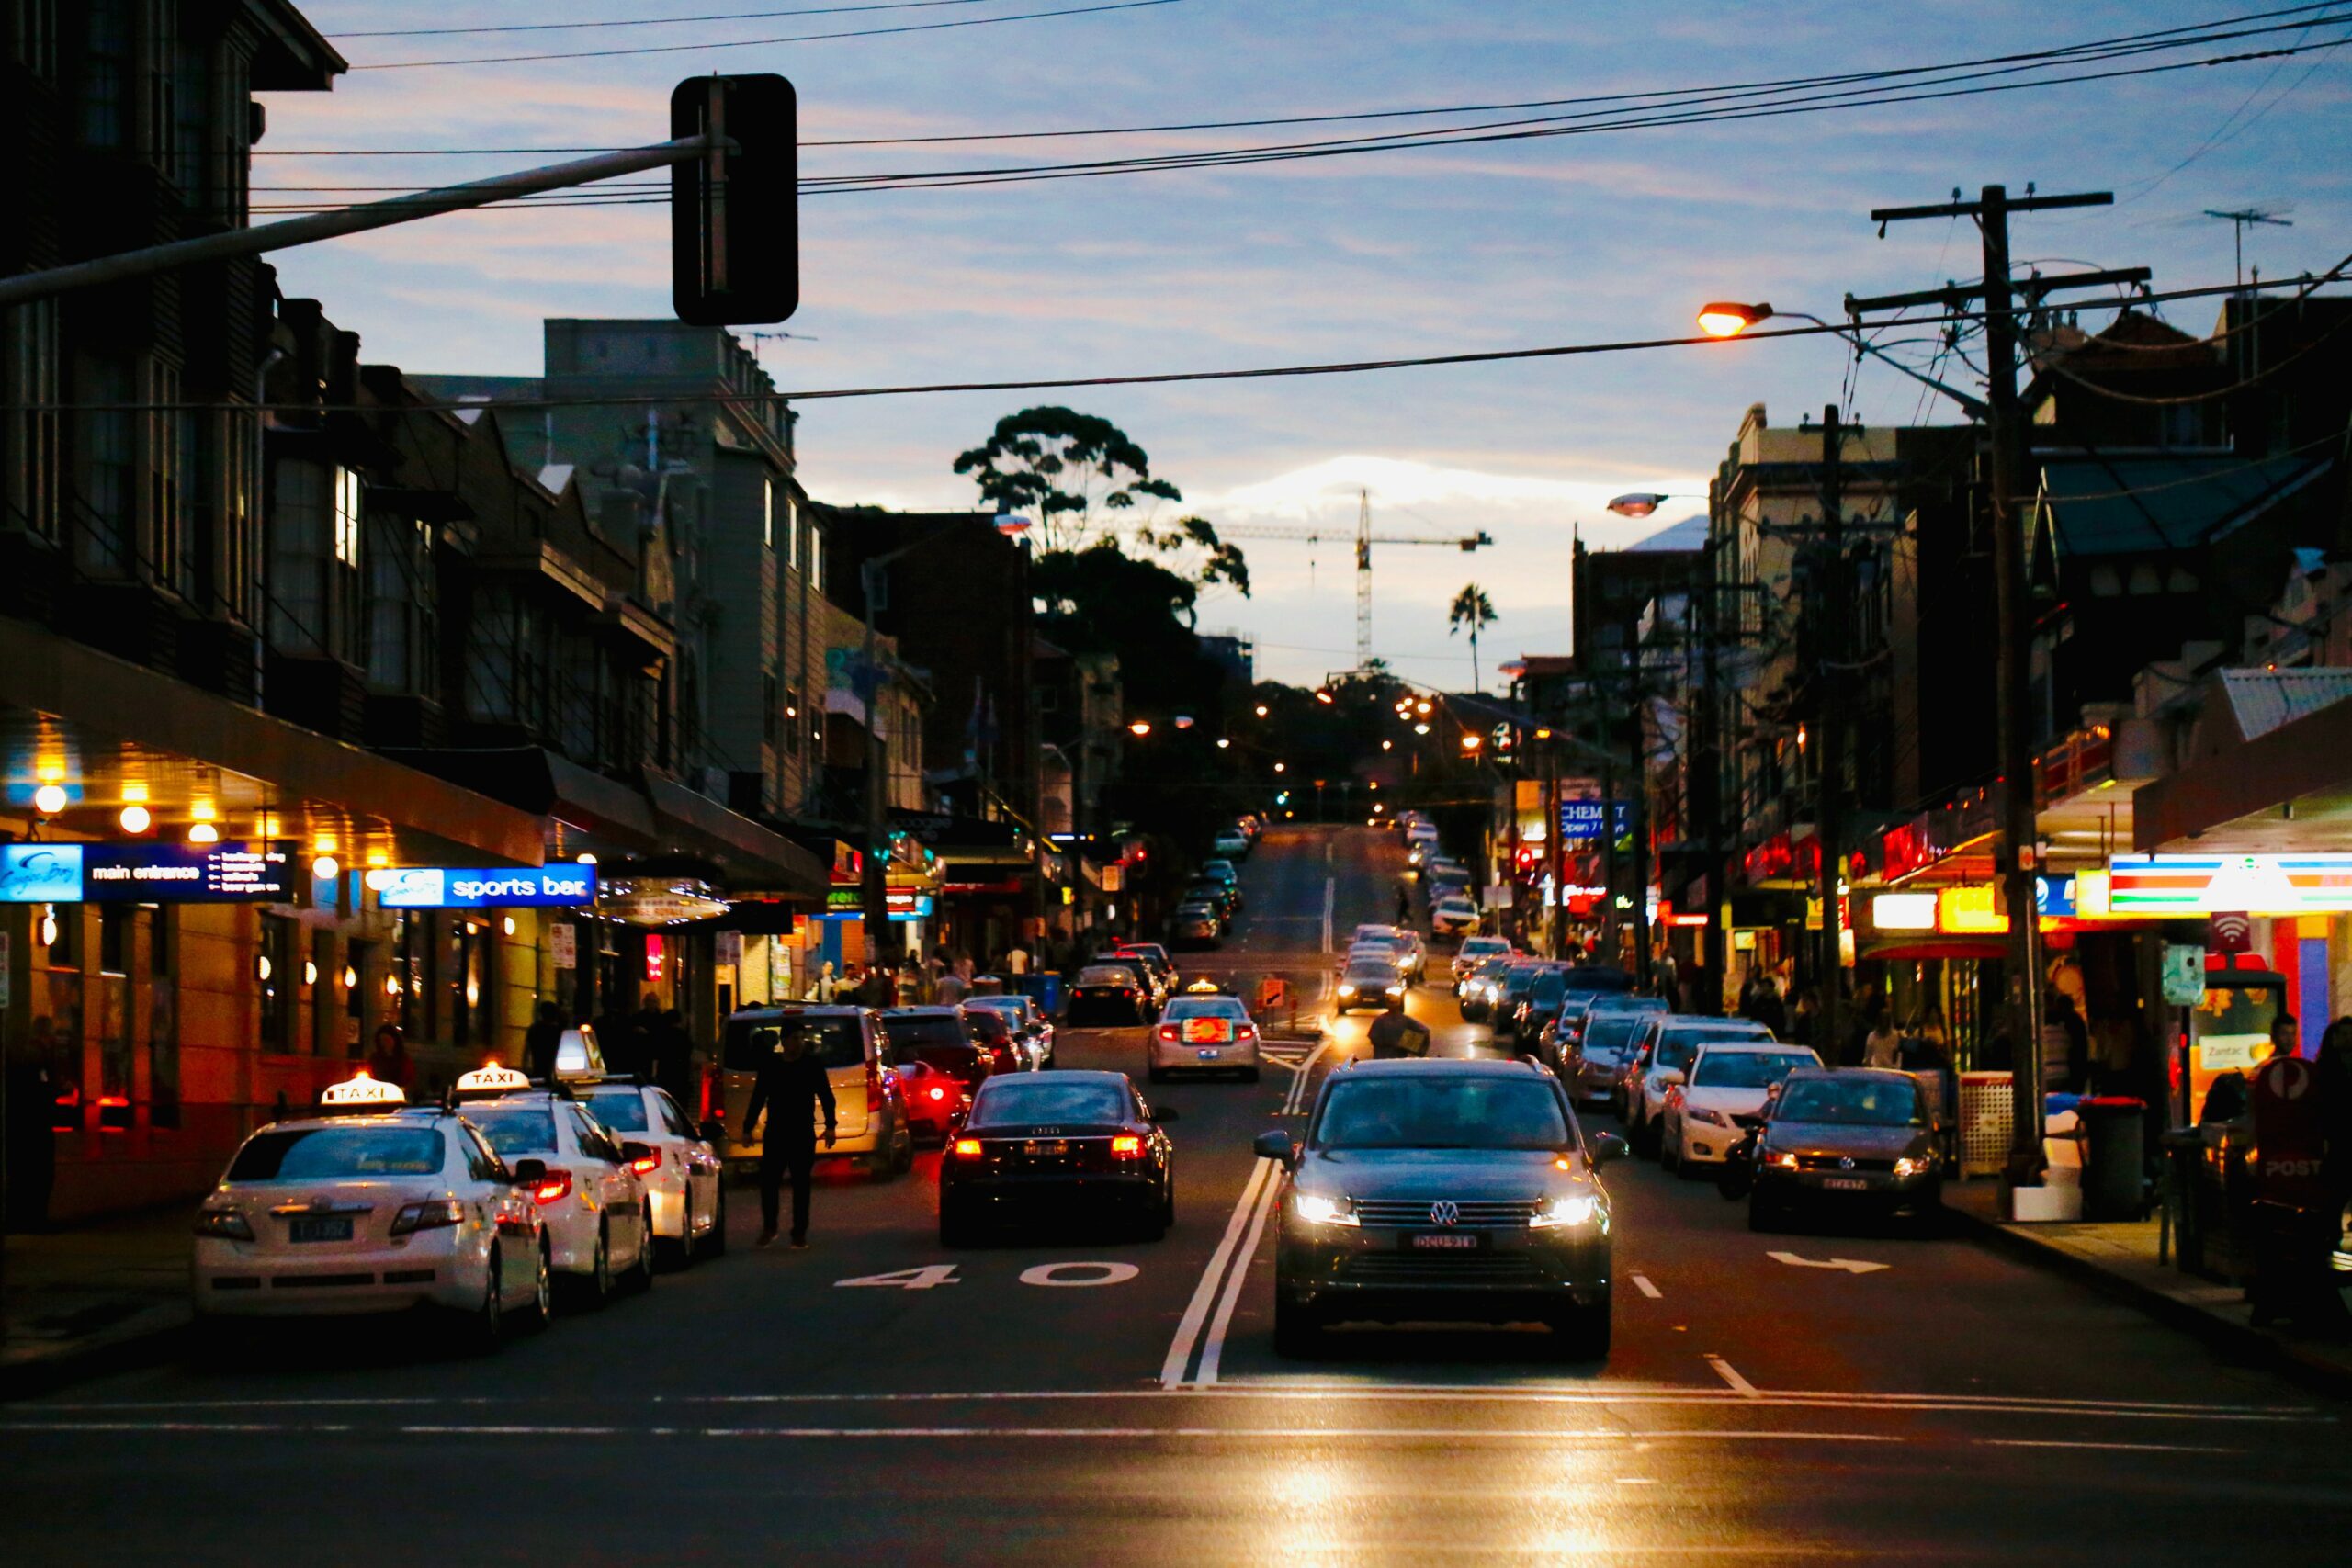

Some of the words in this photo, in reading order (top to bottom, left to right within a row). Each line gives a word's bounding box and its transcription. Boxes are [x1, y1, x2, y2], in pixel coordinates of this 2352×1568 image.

[1562, 806, 1625, 818] CHEMT
[93, 865, 130, 880] main
[133, 865, 200, 880] entrance
[453, 879, 536, 900] sports
[543, 876, 585, 896] bar
[472, 1073, 514, 1083] TAXI
[338, 1088, 385, 1099] TAXI
[2266, 1160, 2322, 1178] POST
